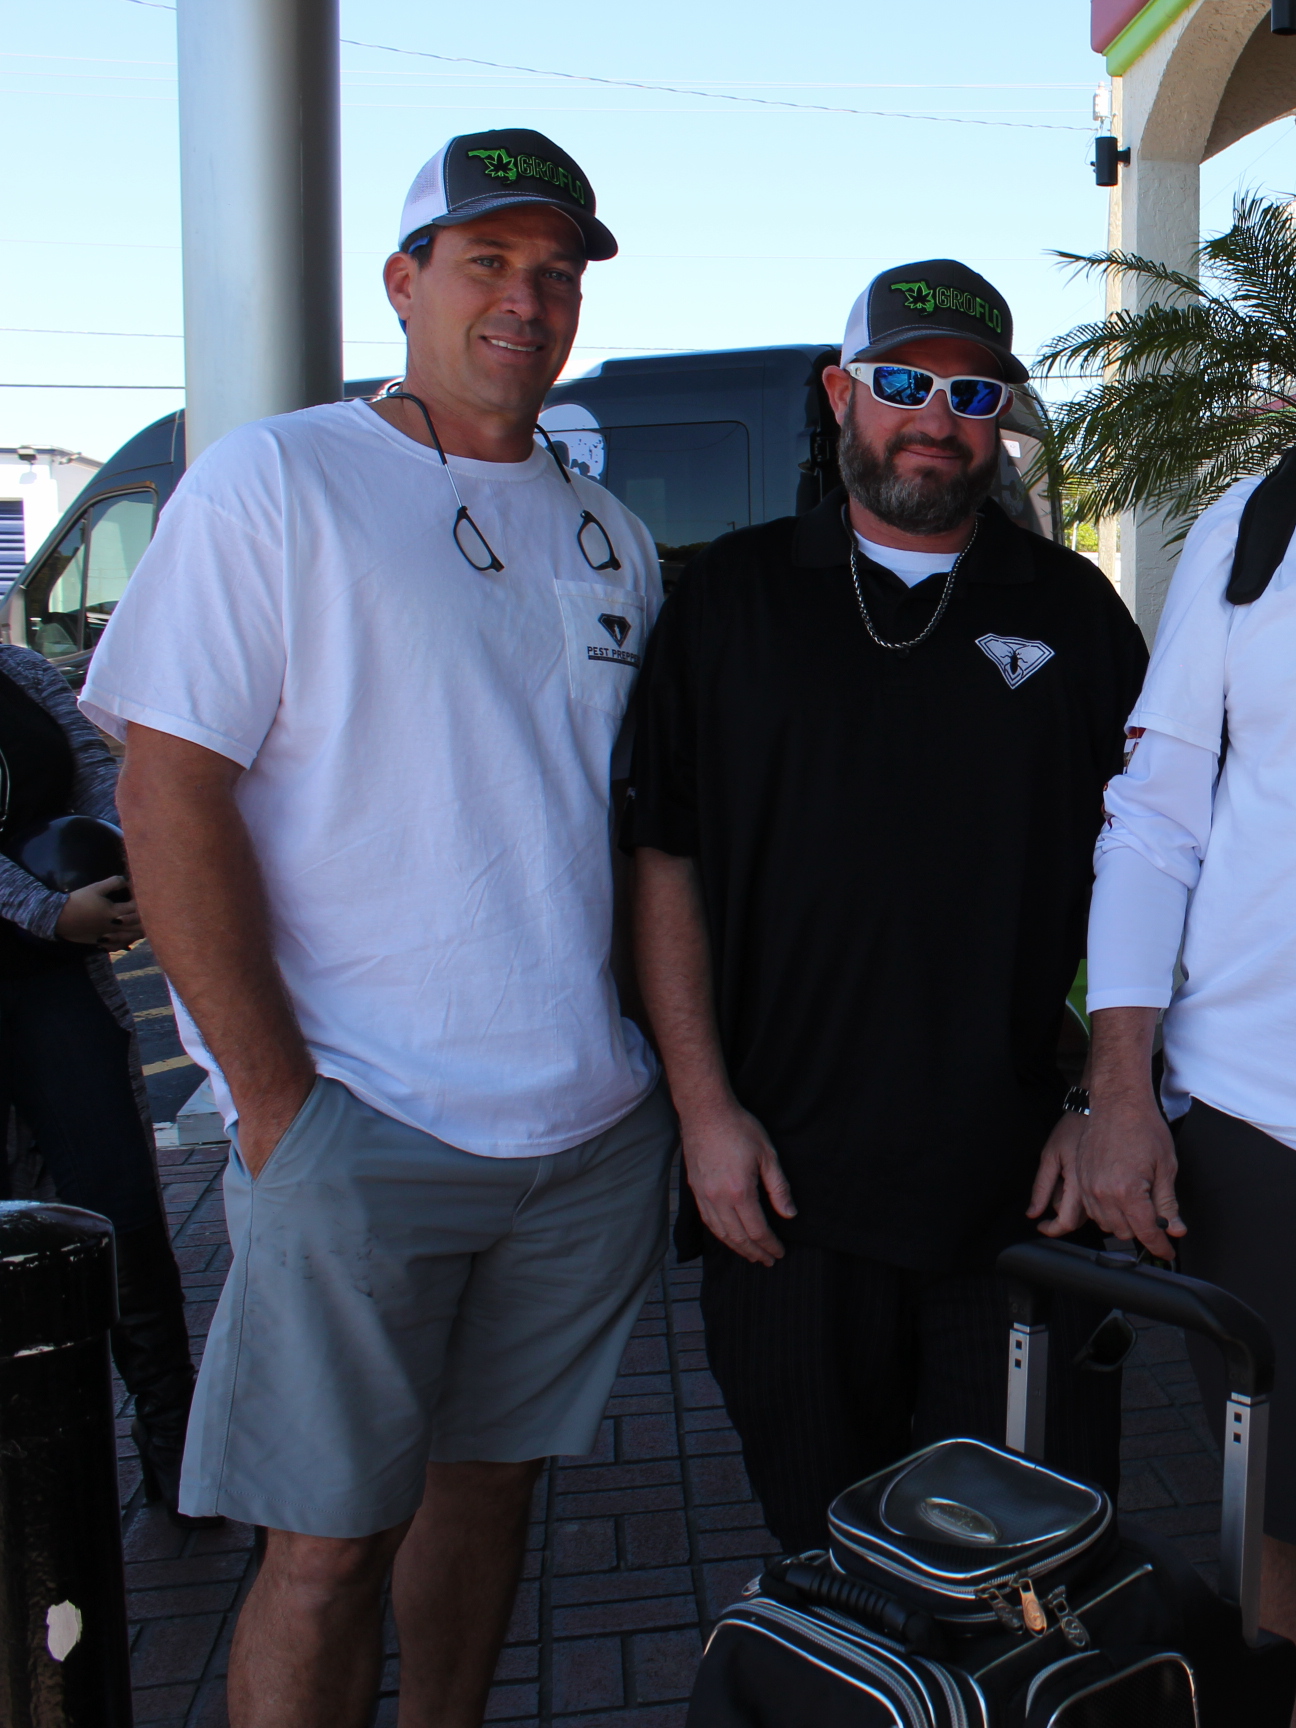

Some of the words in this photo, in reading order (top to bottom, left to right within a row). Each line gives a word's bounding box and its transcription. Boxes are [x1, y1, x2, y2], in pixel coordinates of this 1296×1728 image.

[517, 154, 585, 205] GROFLO
[936, 286, 1002, 333] GROFLO
[587, 646, 609, 656] PEST
